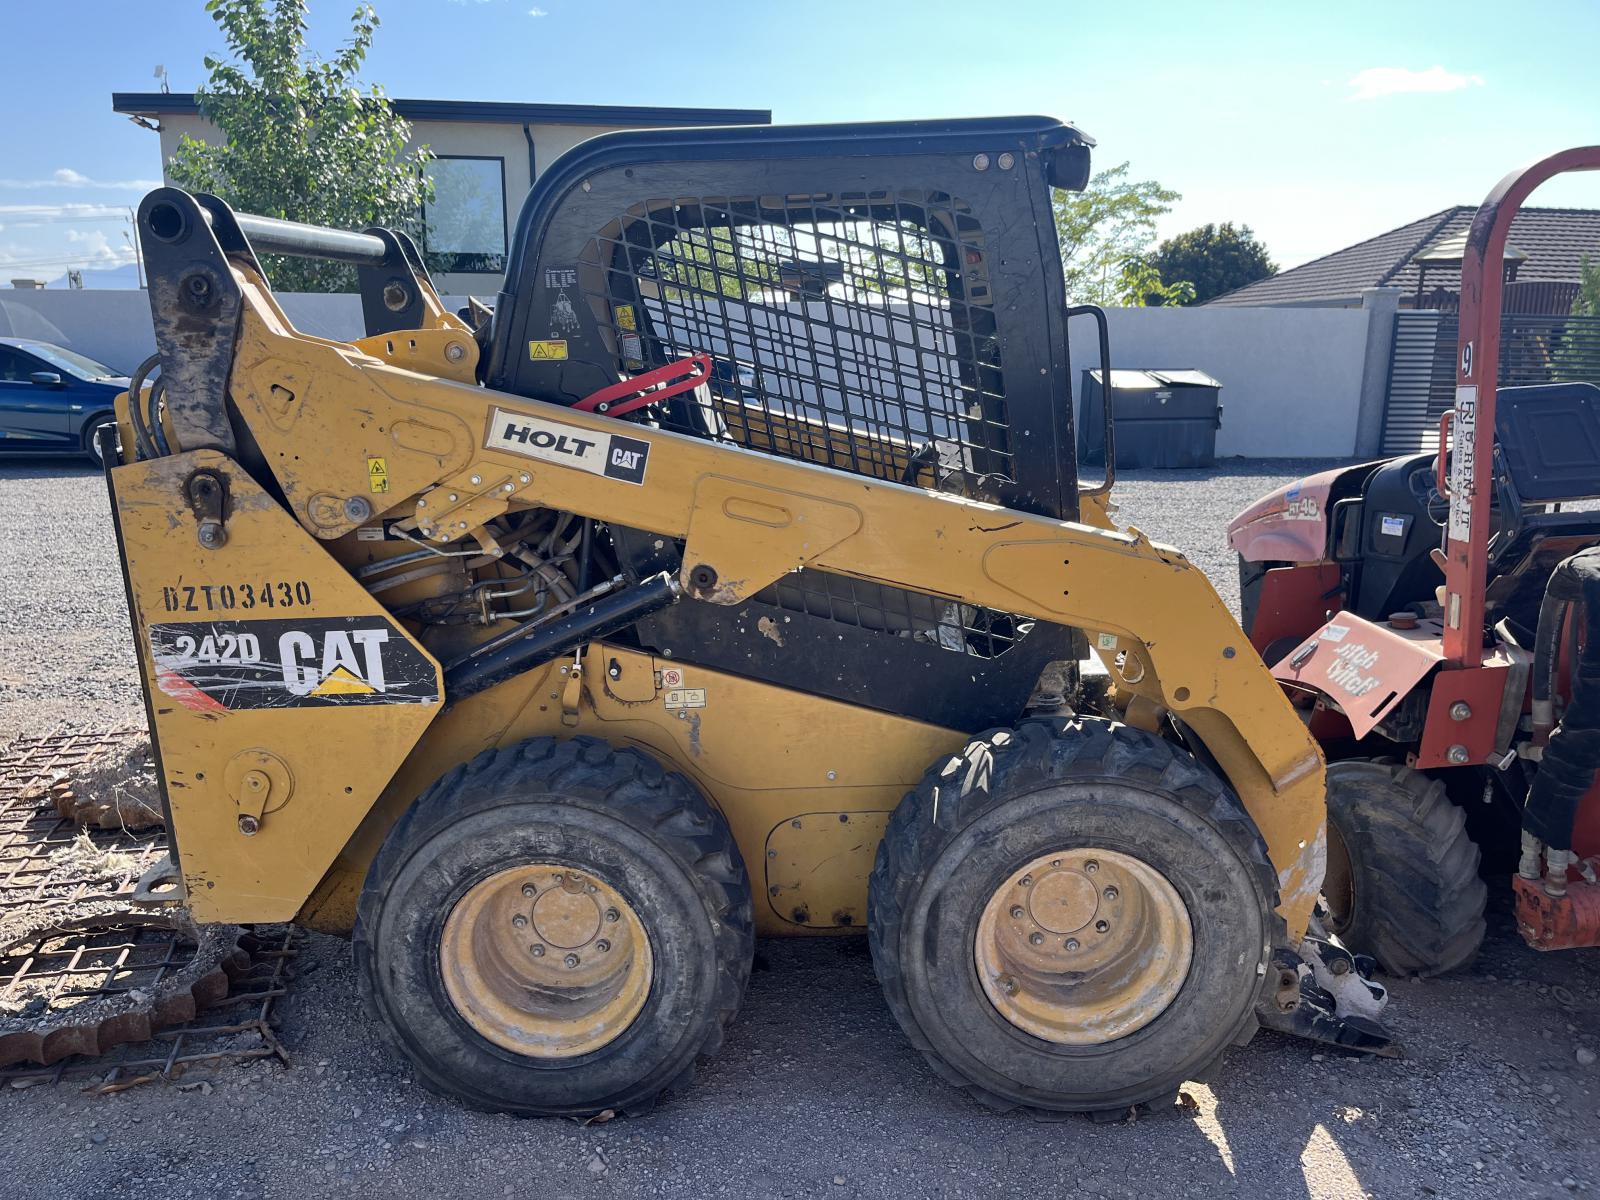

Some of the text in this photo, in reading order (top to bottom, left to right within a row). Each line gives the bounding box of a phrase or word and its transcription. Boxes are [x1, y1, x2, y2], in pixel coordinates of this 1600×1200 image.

[503, 423, 644, 470] HOLT CAT
[163, 581, 312, 612] DZT03430
[175, 628, 389, 697] 242D CAT
